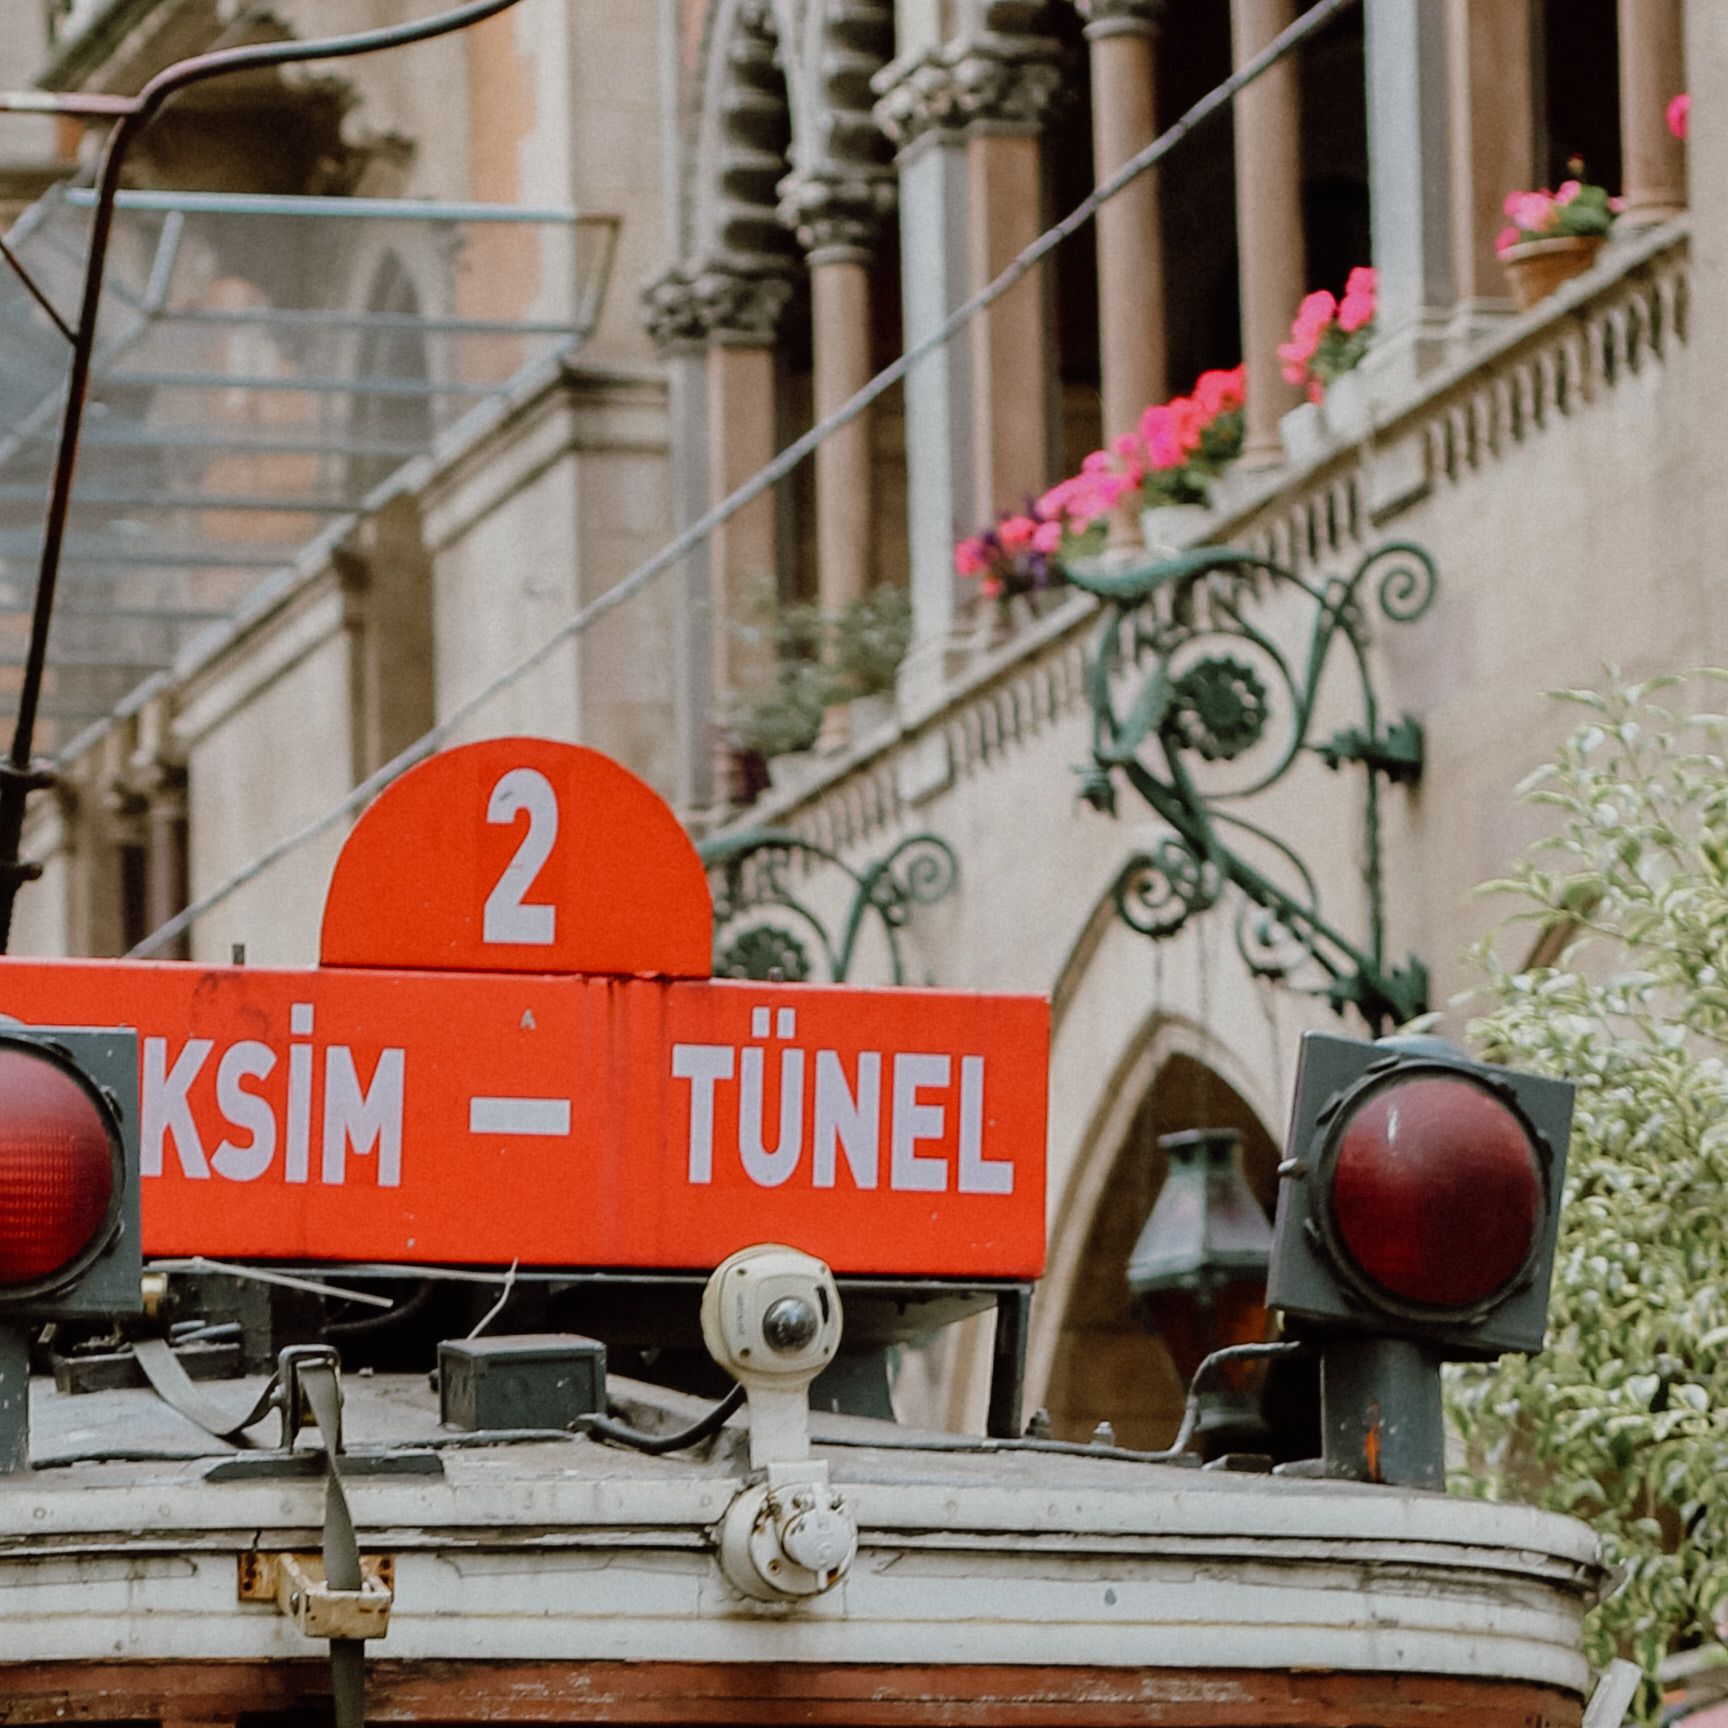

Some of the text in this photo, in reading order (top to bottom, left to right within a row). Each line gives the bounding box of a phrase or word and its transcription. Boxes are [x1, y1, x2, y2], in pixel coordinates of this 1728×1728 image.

[483, 766, 559, 946] 2
[139, 1002, 405, 1188] KSİM
[672, 1005, 1015, 1195] TÜNEL
